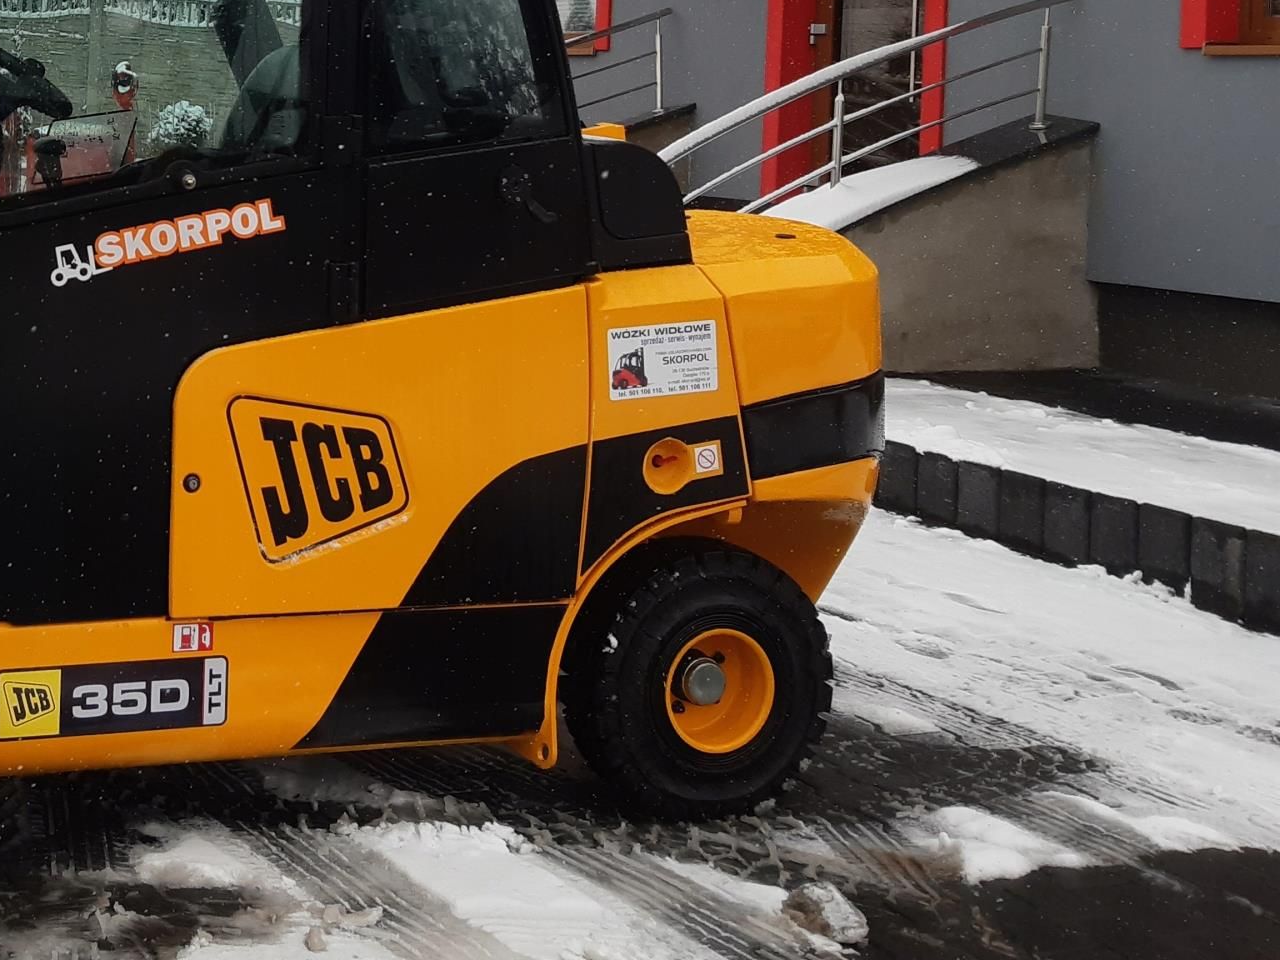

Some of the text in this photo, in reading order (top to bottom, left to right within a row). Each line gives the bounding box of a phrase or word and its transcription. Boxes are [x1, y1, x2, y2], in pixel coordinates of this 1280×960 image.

[96, 200, 284, 266] SKORPOL
[611, 324, 711, 340] WÓZKI WIDŁOWE
[662, 353, 710, 366] SKORPOL
[259, 416, 394, 547] JCB
[12, 668, 222, 722] JCB 35D TLT
